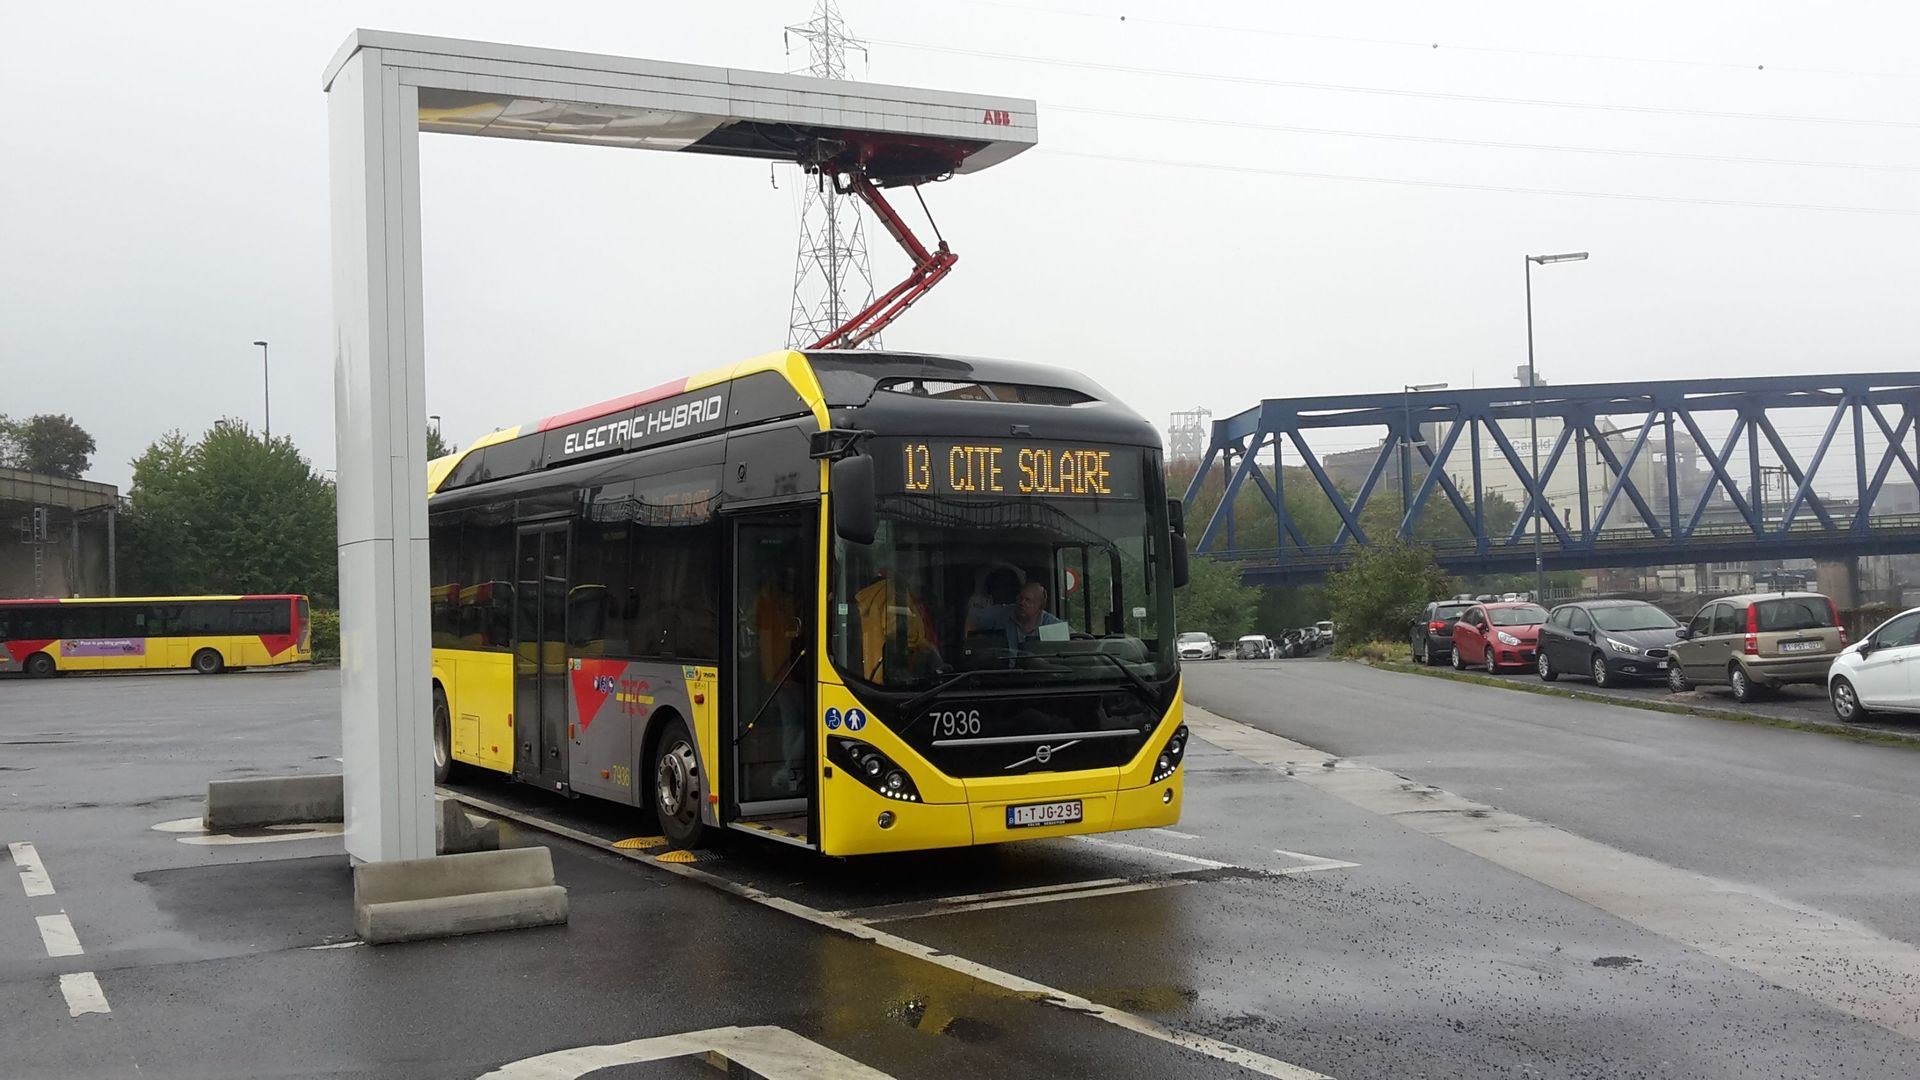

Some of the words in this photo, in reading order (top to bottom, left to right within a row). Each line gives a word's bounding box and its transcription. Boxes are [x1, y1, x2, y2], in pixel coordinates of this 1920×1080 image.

[983, 109, 1011, 126] ABB
[564, 415, 645, 454] ELECTRIC
[647, 395, 722, 435] HYBRID
[1512, 438, 1551, 451] Carid
[905, 444, 930, 490] 13
[949, 446, 1003, 491] CITE
[1018, 448, 1111, 494] SOLAIRE
[620, 679, 651, 717] TEC
[929, 710, 981, 737] 7936
[612, 764, 630, 787] 7936
[1017, 804, 1080, 821] 1-TJG-295
